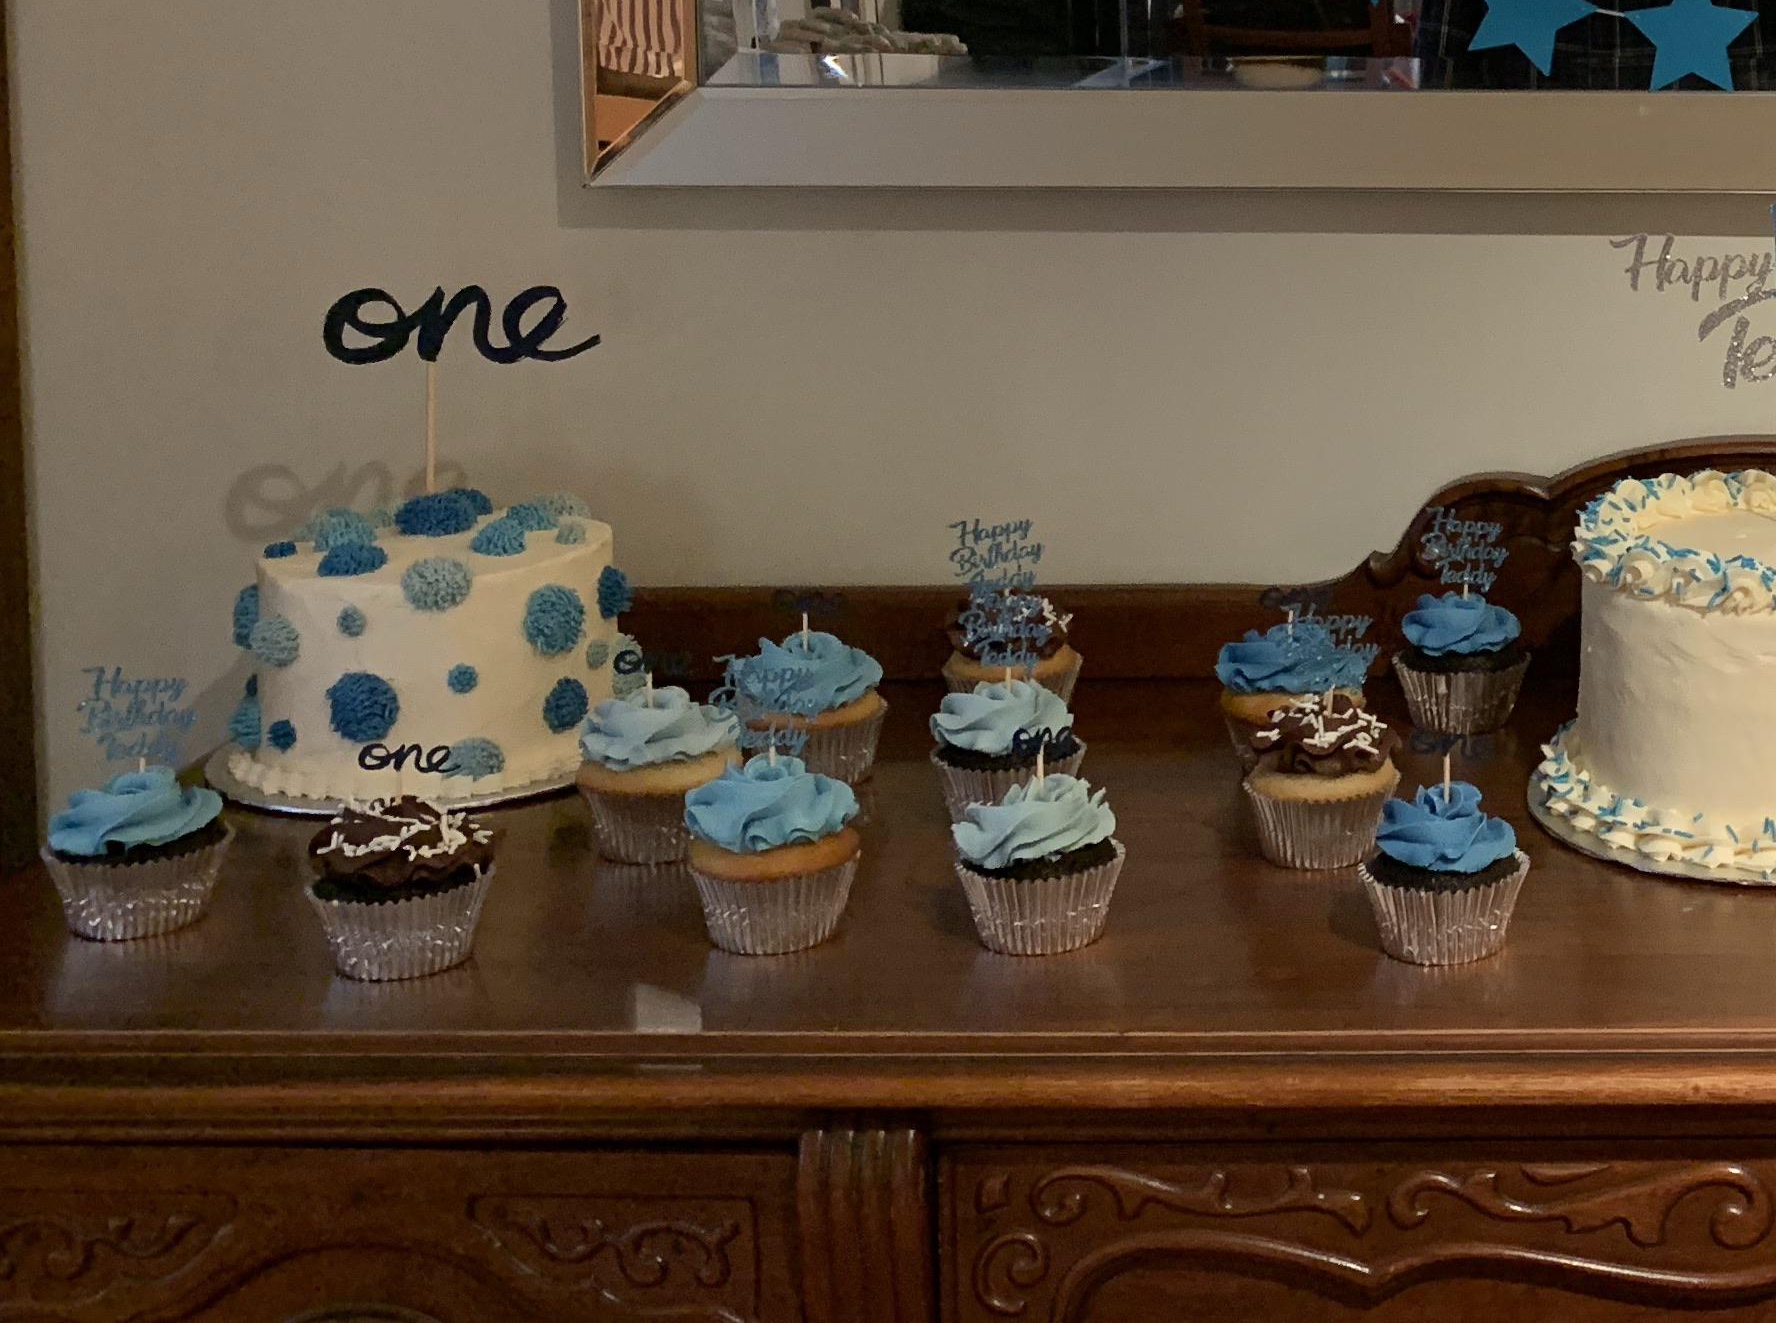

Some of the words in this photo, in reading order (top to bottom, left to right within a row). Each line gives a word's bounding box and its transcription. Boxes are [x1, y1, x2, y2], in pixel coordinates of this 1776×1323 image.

[1609, 232, 1774, 303] Happy
[323, 285, 601, 365] one
[946, 518, 1034, 546] Happy
[1425, 507, 1504, 543] Happy
[949, 540, 1045, 578] Birthday
[1421, 532, 1510, 568] Birthday
[1434, 558, 1497, 593] Teddy
[959, 610, 1052, 647] Birthday
[974, 638, 1040, 673] Teddy
[80, 665, 189, 702] Happy
[77, 697, 198, 734] Birthday
[358, 743, 461, 773] one
